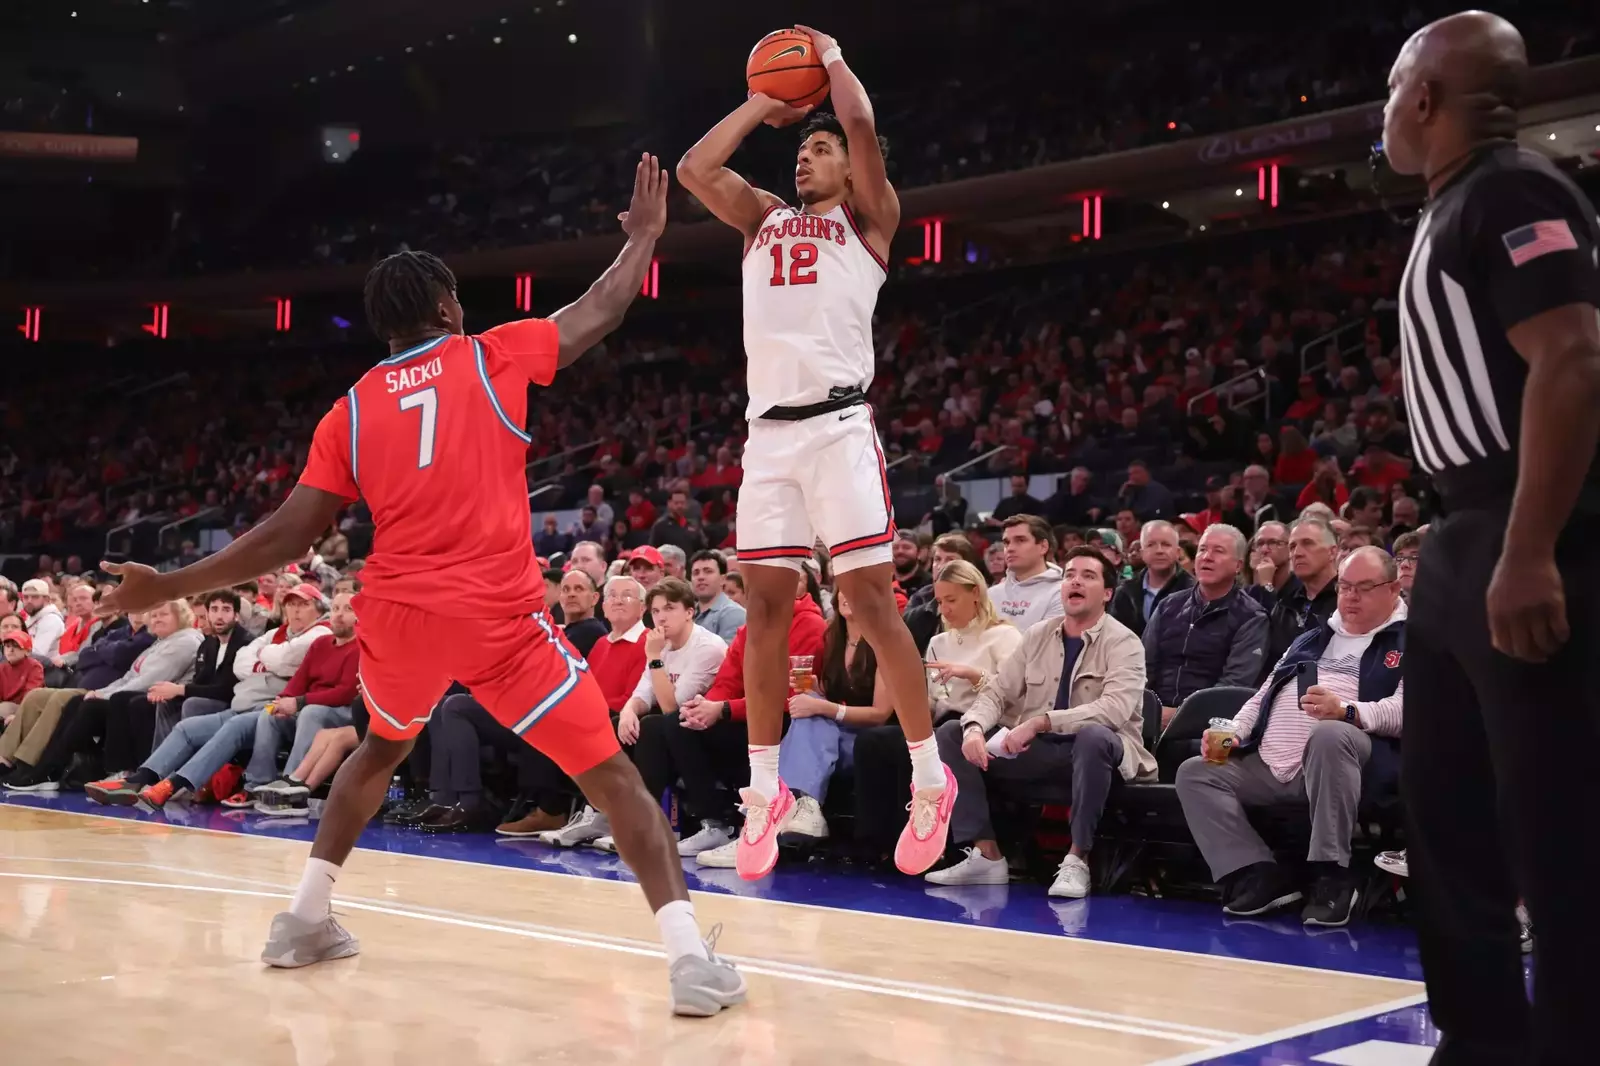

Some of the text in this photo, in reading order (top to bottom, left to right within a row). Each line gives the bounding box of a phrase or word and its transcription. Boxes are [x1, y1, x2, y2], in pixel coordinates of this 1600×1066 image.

[774, 216, 846, 246] JOHN'S
[770, 242, 818, 286] 12
[385, 357, 443, 393] SACKO
[398, 385, 438, 469] 7
